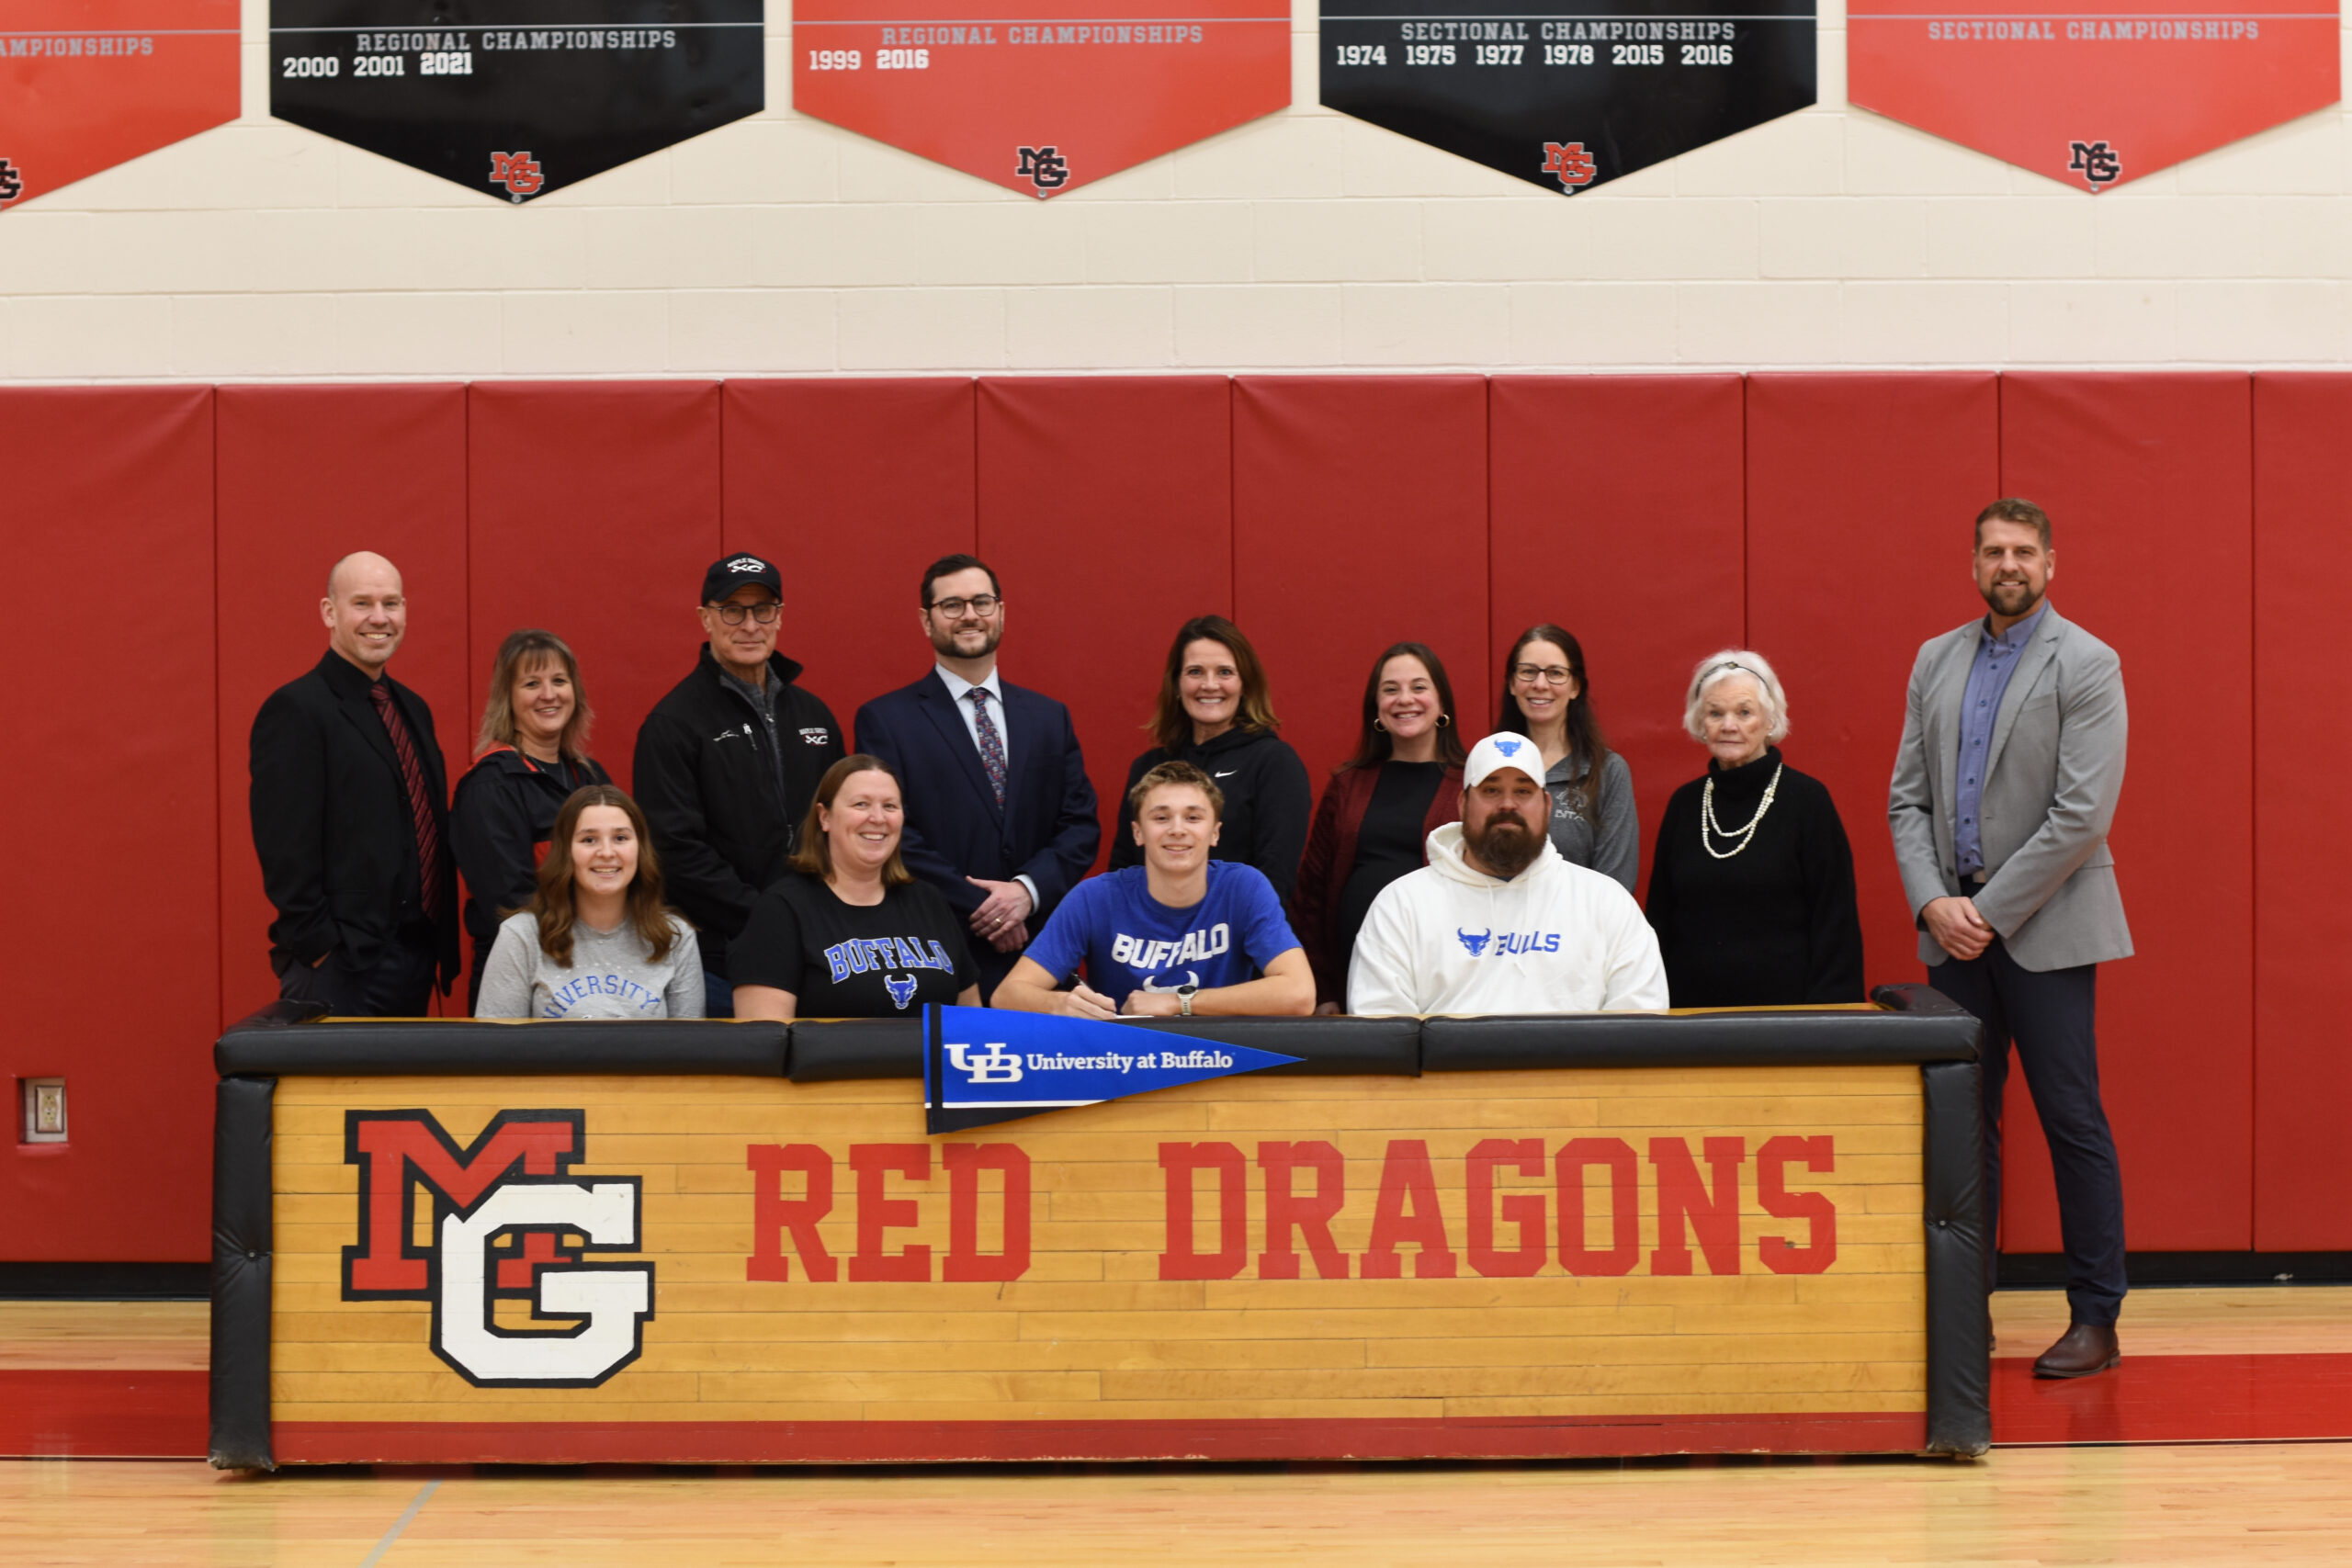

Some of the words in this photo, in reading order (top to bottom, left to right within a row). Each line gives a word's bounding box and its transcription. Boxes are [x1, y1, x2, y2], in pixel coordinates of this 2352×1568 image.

[356, 33, 471, 51] REGIONAL
[482, 30, 676, 50] CHAMPIONSHIPS
[881, 27, 997, 45] REGIONAL
[1008, 25, 1203, 44] CHAMPIONSHIPS
[1400, 22, 1529, 40] SECTIONAL
[1541, 21, 1736, 40] CHAMPIONSHIPS
[1928, 20, 2055, 39] SECTIONAL
[2066, 20, 2259, 39] CHAMPIONSHIPS
[283, 57, 339, 78] 2000
[353, 56, 405, 76] 2001
[420, 52, 472, 75] 2021
[809, 50, 861, 71] 1999
[876, 49, 929, 69] 2016
[1337, 45, 1387, 65] 1974
[1406, 45, 1456, 65] 1975
[1476, 45, 1524, 65] 1977
[1544, 44, 1594, 65] 1978
[1611, 44, 1664, 65] 2015
[1680, 44, 1733, 65] 2016
[1111, 922, 1229, 969] BUFFALO
[824, 937, 955, 984] BUFFALO
[944, 1043, 1023, 1083] UB
[1026, 1053, 1134, 1074] University
[1136, 1054, 1156, 1068] at
[1160, 1051, 1233, 1068] Buffalo
[747, 1143, 1031, 1282] RED
[1159, 1135, 1837, 1280] DRAGONS
